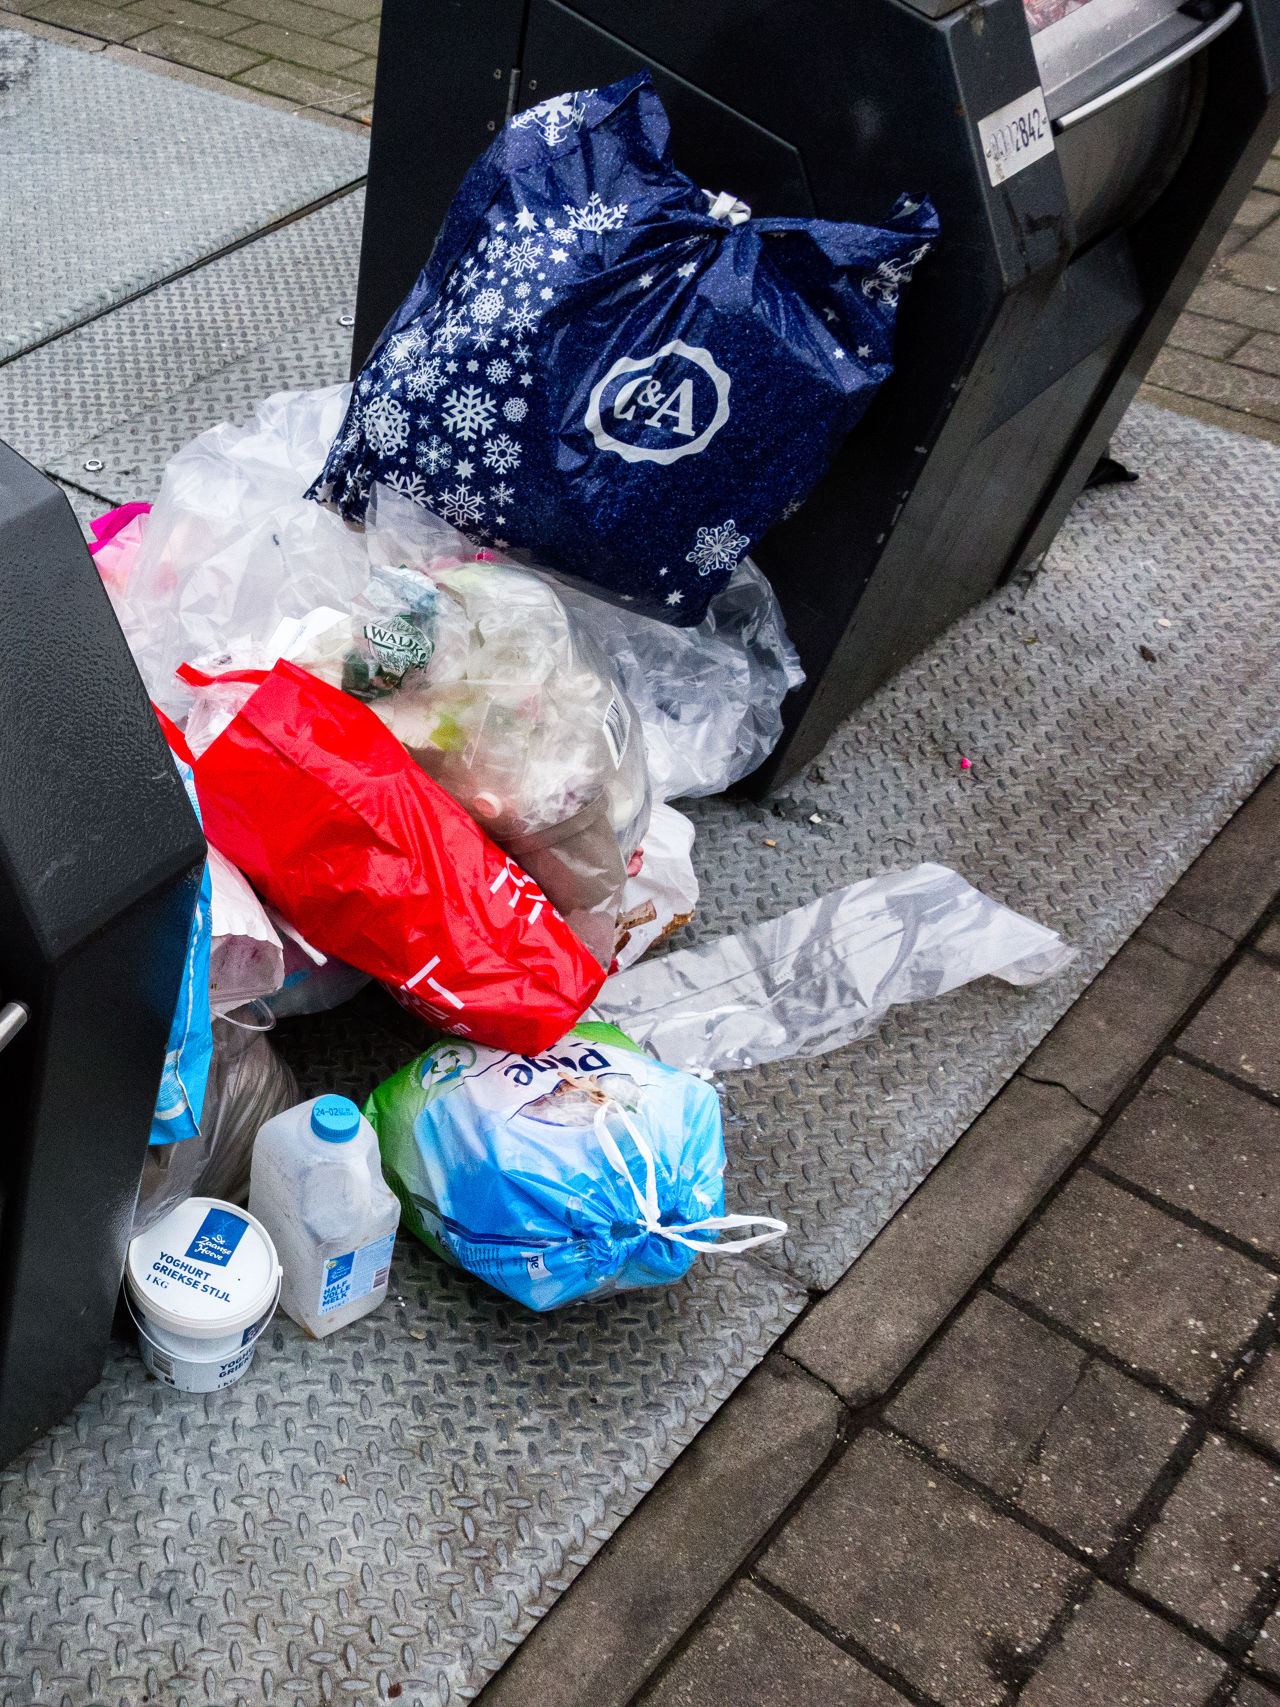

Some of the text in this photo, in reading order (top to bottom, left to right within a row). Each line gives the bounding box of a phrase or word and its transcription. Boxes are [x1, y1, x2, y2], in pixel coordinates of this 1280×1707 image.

[991, 108, 1044, 160] 2842
[614, 375, 696, 437] C&A
[194, 1244, 223, 1261] Hoeve
[195, 1236, 233, 1256] Zaanse
[159, 1252, 211, 1281] YOGHURT
[528, 1255, 540, 1269] ge
[152, 1262, 231, 1303] GRIEKSE STIJL
[152, 1277, 170, 1290] KG
[324, 1280, 349, 1294] HALF
[322, 1293, 347, 1306] MELK
[323, 1284, 351, 1300] VOLLE
